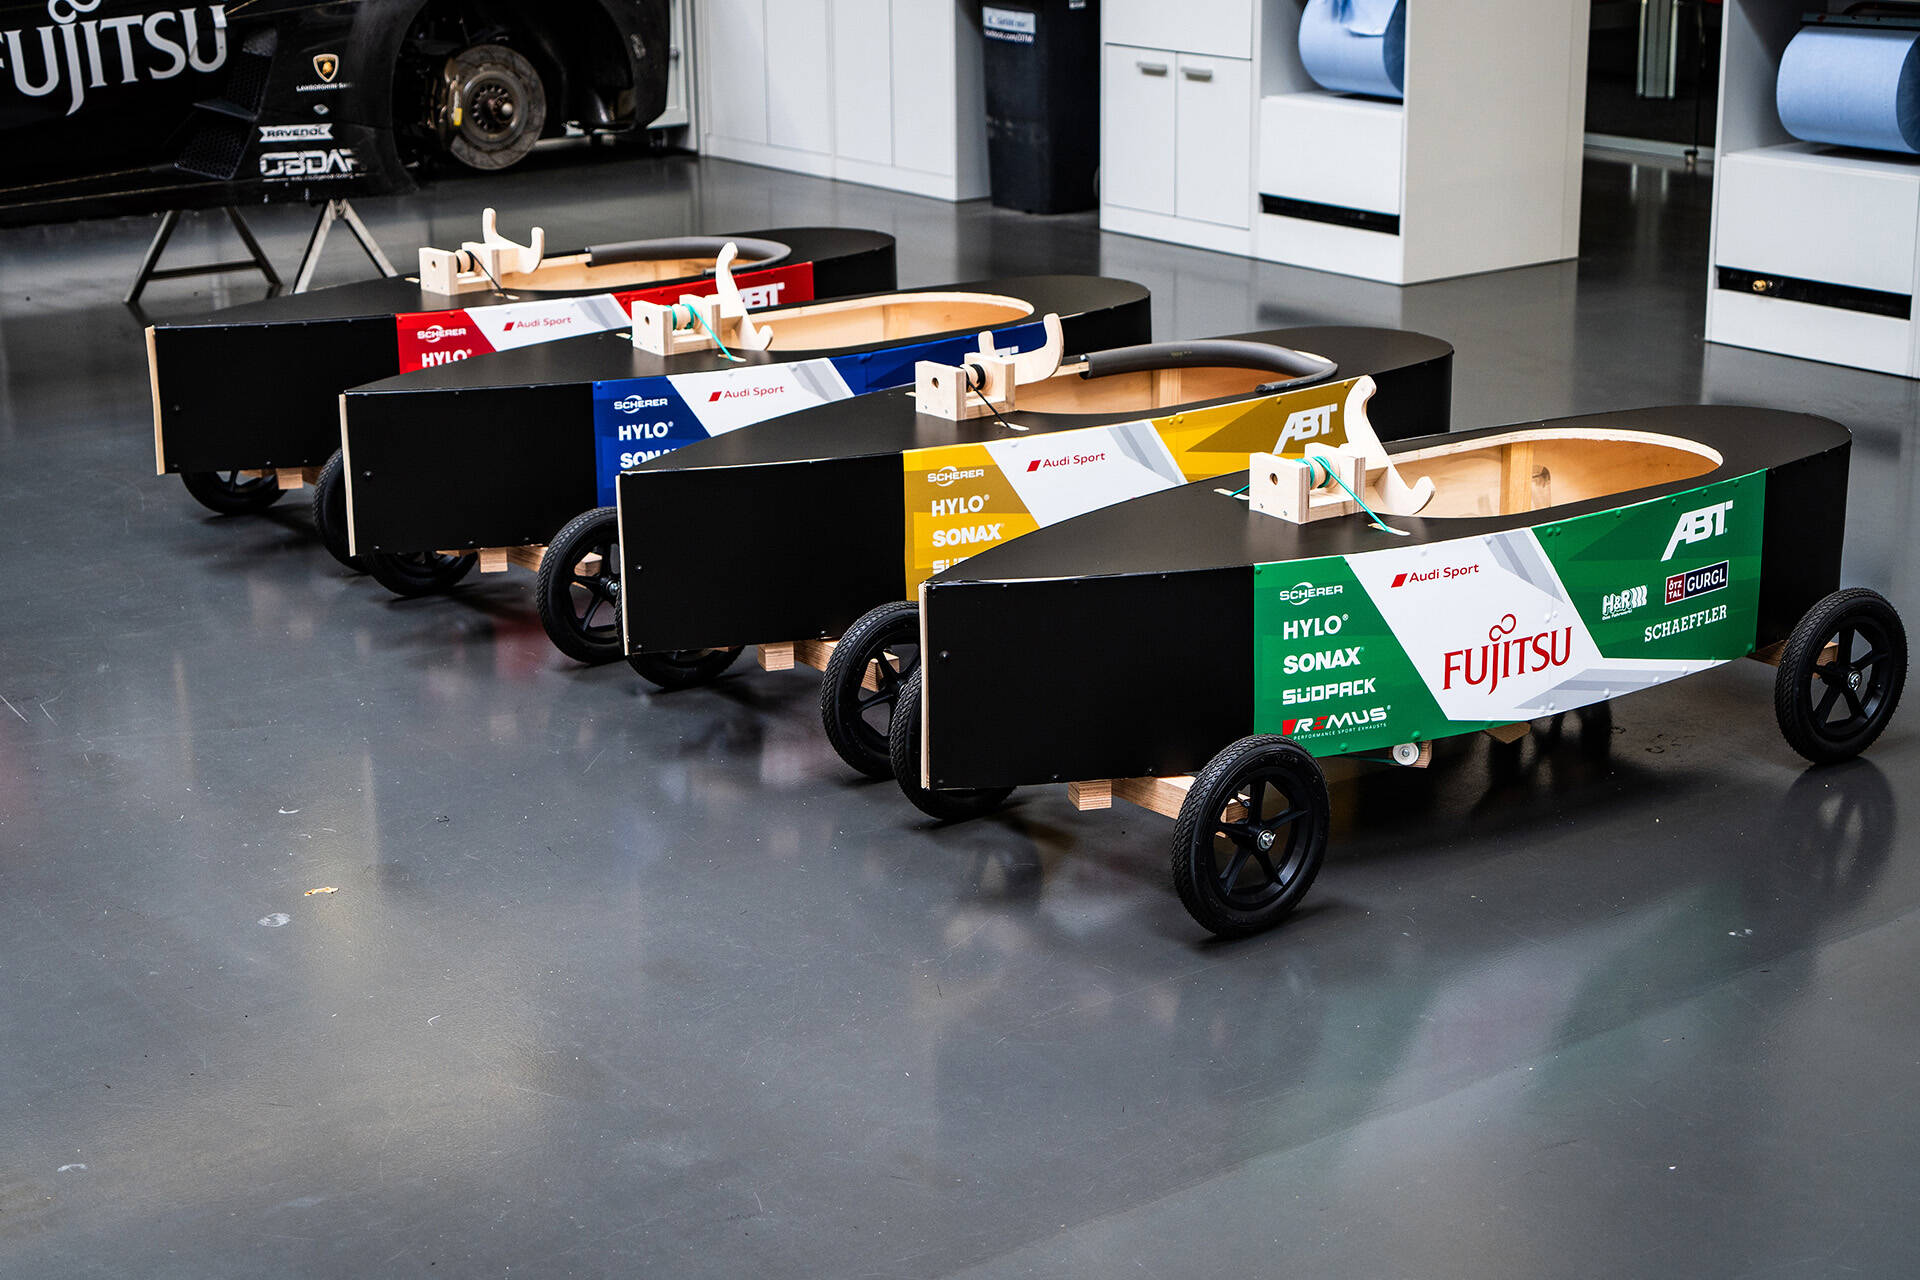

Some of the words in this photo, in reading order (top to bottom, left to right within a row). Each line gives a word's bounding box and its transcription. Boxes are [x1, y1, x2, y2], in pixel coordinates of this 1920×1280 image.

[0, 5, 227, 116] UJITSU
[267, 127, 325, 137] RAVENOL
[739, 282, 785, 309] BT
[517, 317, 540, 329] Audi
[543, 316, 572, 327] Sport
[417, 328, 467, 340] SCHERER
[724, 389, 750, 399] Audi
[753, 386, 784, 397] Sport
[614, 398, 668, 410] SCHERER
[1272, 403, 1338, 455] ABT
[620, 448, 677, 469] SON
[1043, 456, 1070, 468] Audi
[1073, 453, 1105, 465] Sport
[928, 469, 984, 483] SCHERER
[932, 523, 1002, 547] SONAX
[1661, 500, 1733, 562] ABT
[1409, 569, 1440, 583] Audi
[1443, 564, 1479, 579] Sport
[1686, 568, 1726, 592] GURGL
[1280, 585, 1344, 601] SCHERER
[1602, 589, 1632, 617] H&R
[1668, 590, 1682, 600] TAL
[1644, 604, 1727, 643] SCHAEFFLER
[1283, 646, 1361, 674] SONAX
[1442, 626, 1572, 695] FUJITSU
[1282, 677, 1376, 705] SÜDPACK
[1294, 707, 1387, 734] REMUS
[1293, 731, 1336, 740] PERFORMANCE
[1338, 727, 1356, 735] SPORT
